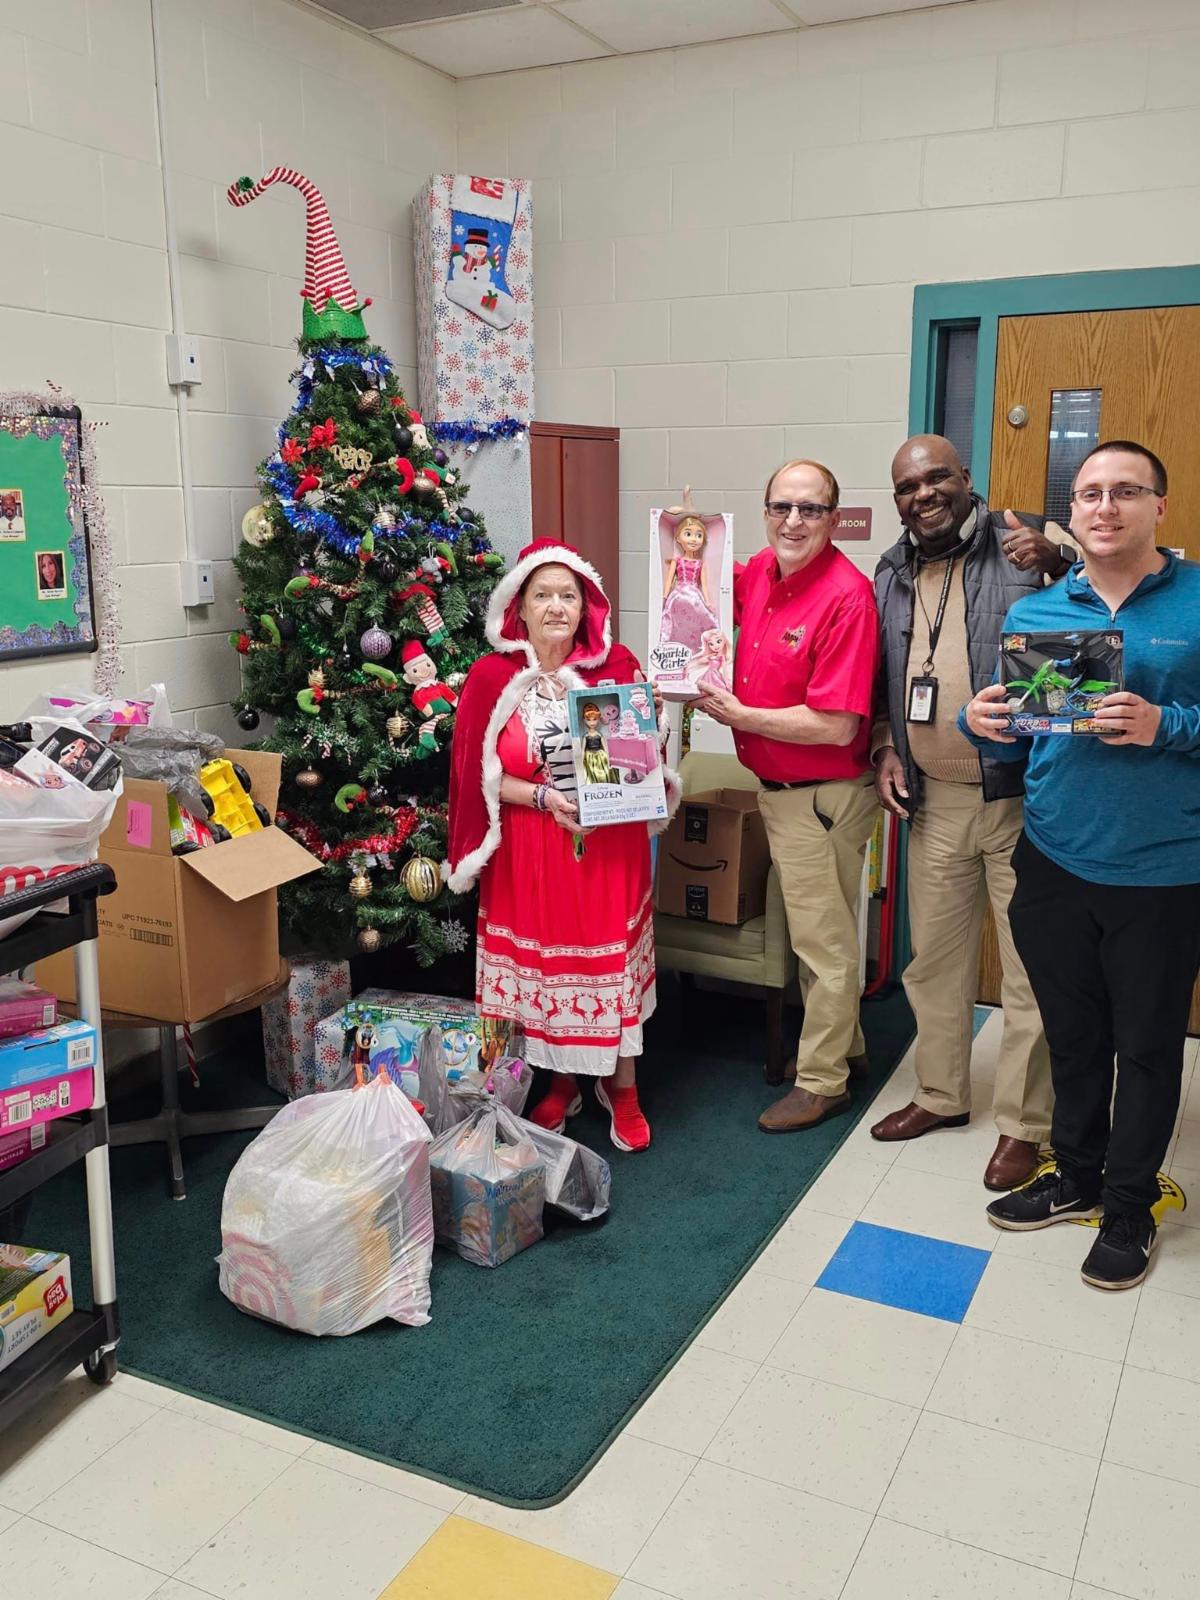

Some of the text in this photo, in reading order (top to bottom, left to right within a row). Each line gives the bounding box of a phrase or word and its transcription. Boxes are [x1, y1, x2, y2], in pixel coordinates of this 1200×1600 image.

[650, 647, 690, 663] Sparkle
[660, 658, 688, 670] Girlz
[584, 788, 623, 802] FROZEN
